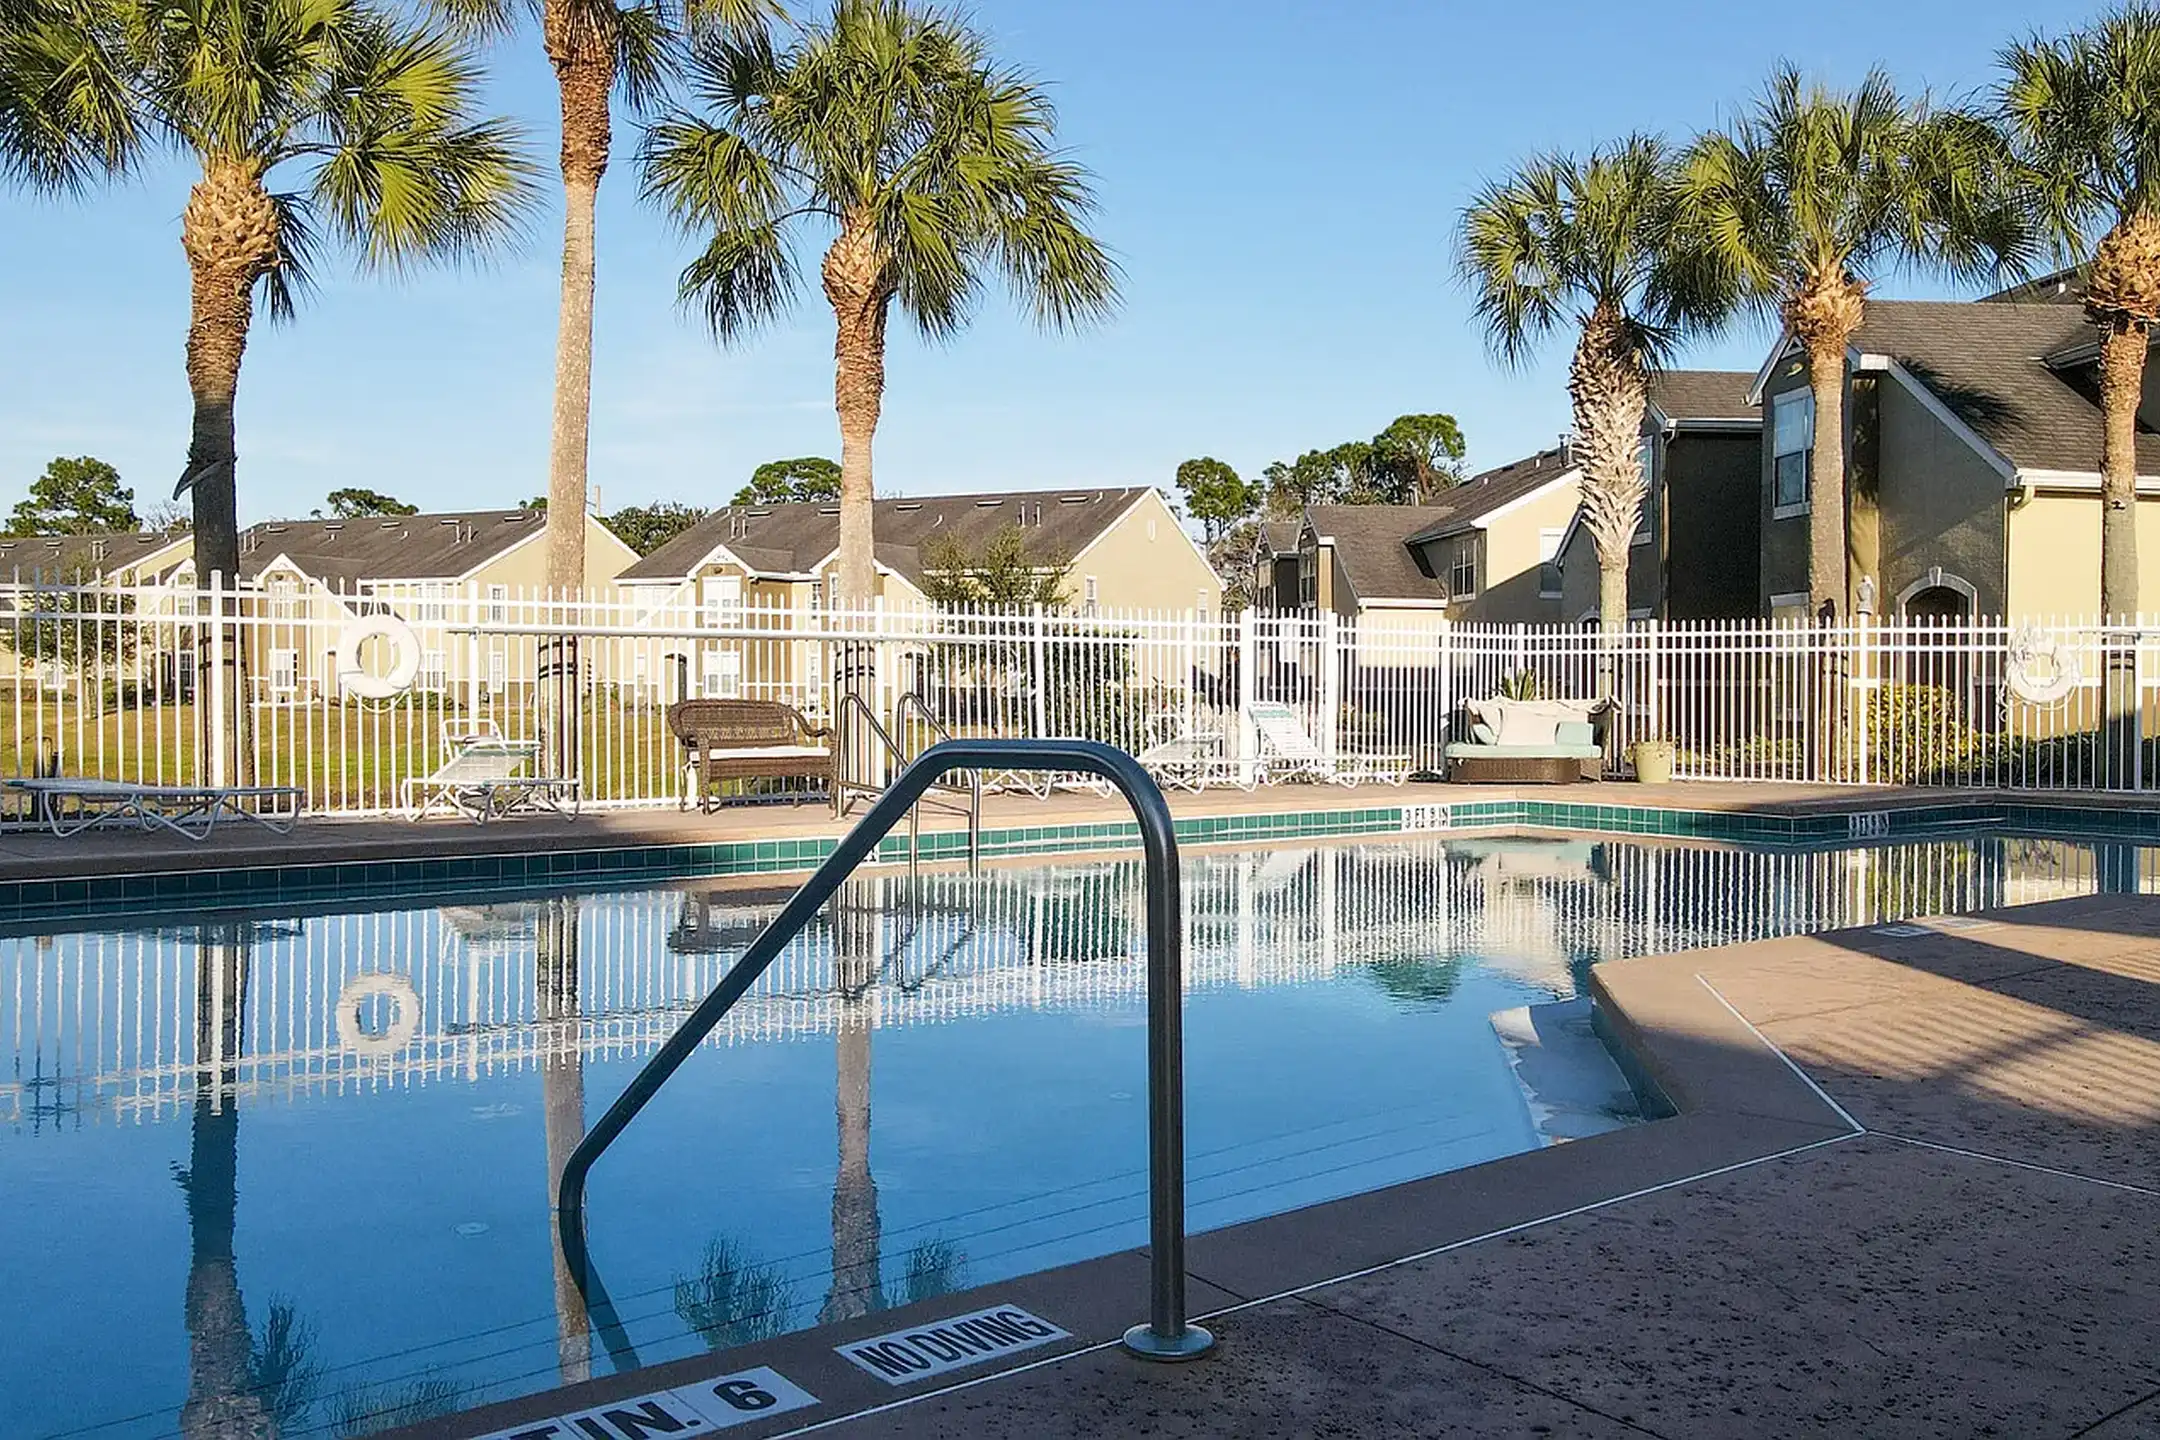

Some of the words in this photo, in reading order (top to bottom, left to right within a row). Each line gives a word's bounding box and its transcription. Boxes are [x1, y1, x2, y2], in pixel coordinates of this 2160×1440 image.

[1405, 809, 1411, 820] 3
[852, 1341, 931, 1377] NO
[904, 1311, 1055, 1362] DIVING
[712, 1380, 778, 1411] 6
